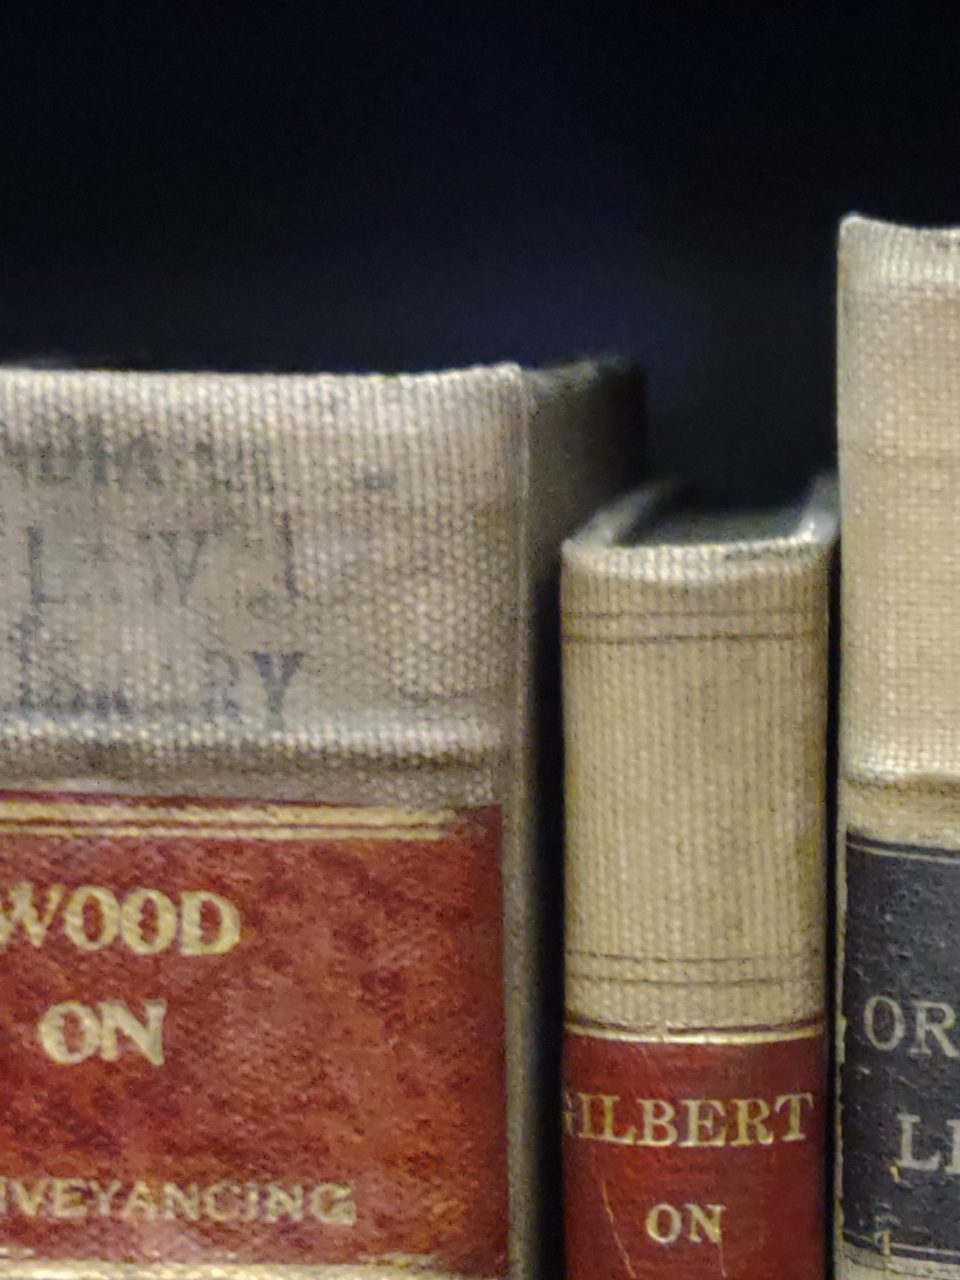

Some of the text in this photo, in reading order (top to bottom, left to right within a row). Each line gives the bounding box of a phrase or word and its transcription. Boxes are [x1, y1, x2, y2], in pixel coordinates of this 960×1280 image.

[38, 1001, 167, 1065] ON
[0, 1176, 357, 1226] VEYANCING
[645, 1203, 726, 1244] ON
